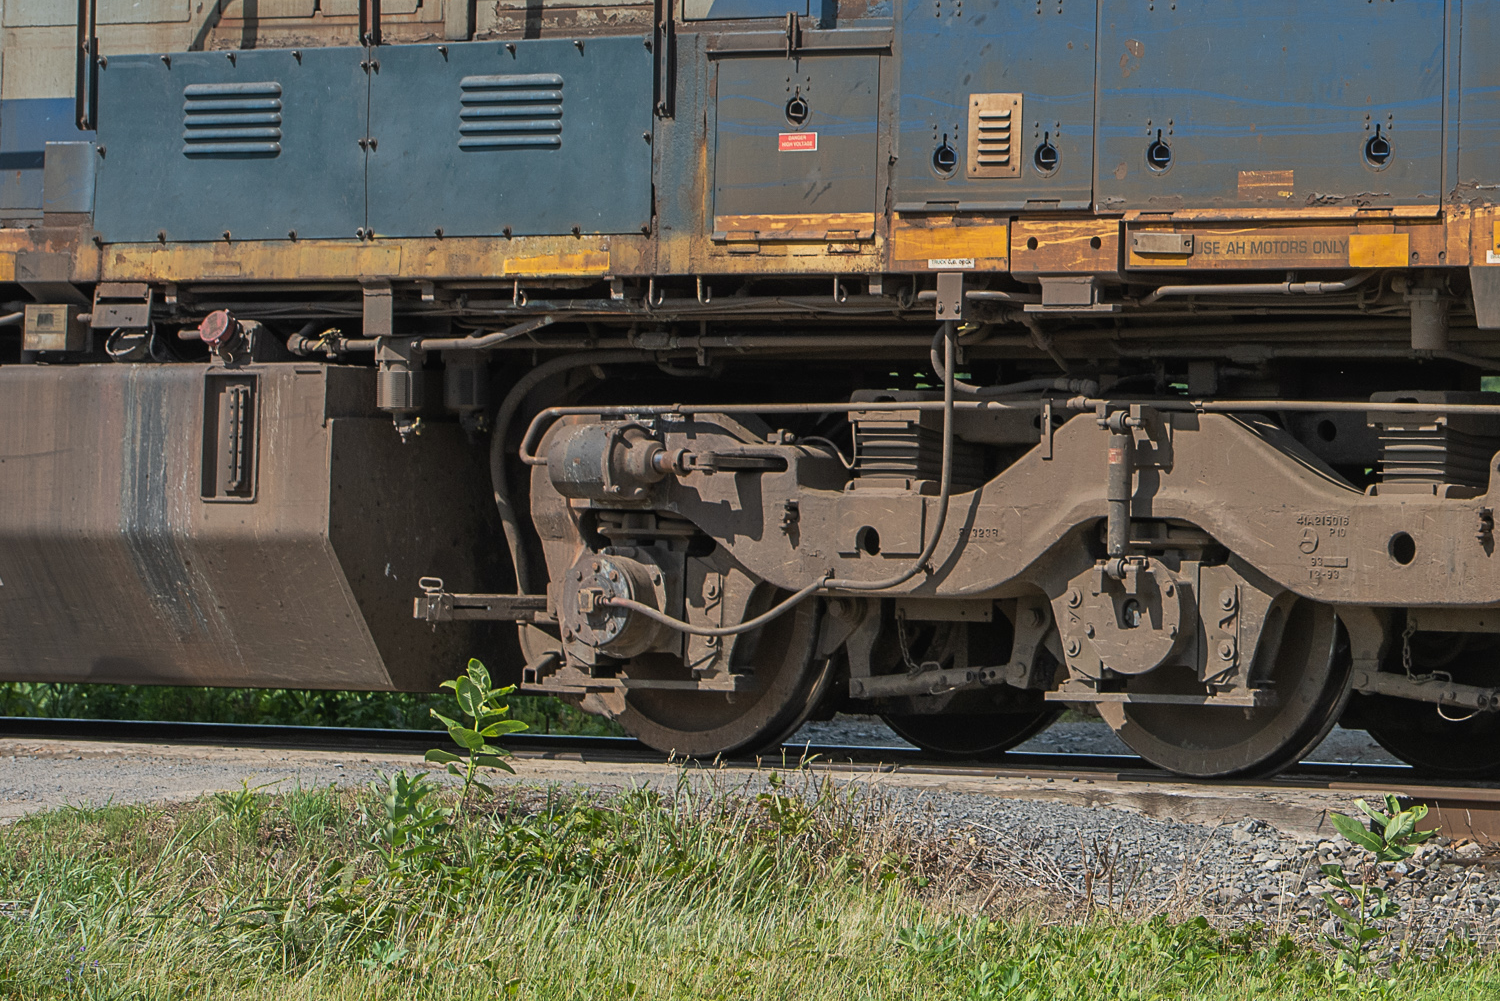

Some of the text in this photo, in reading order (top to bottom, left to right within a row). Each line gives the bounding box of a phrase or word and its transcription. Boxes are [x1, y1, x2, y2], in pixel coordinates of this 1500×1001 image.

[1226, 241, 1245, 255] AH
[1250, 240, 1308, 255] MOTORS
[1313, 240, 1349, 254] ONLY
